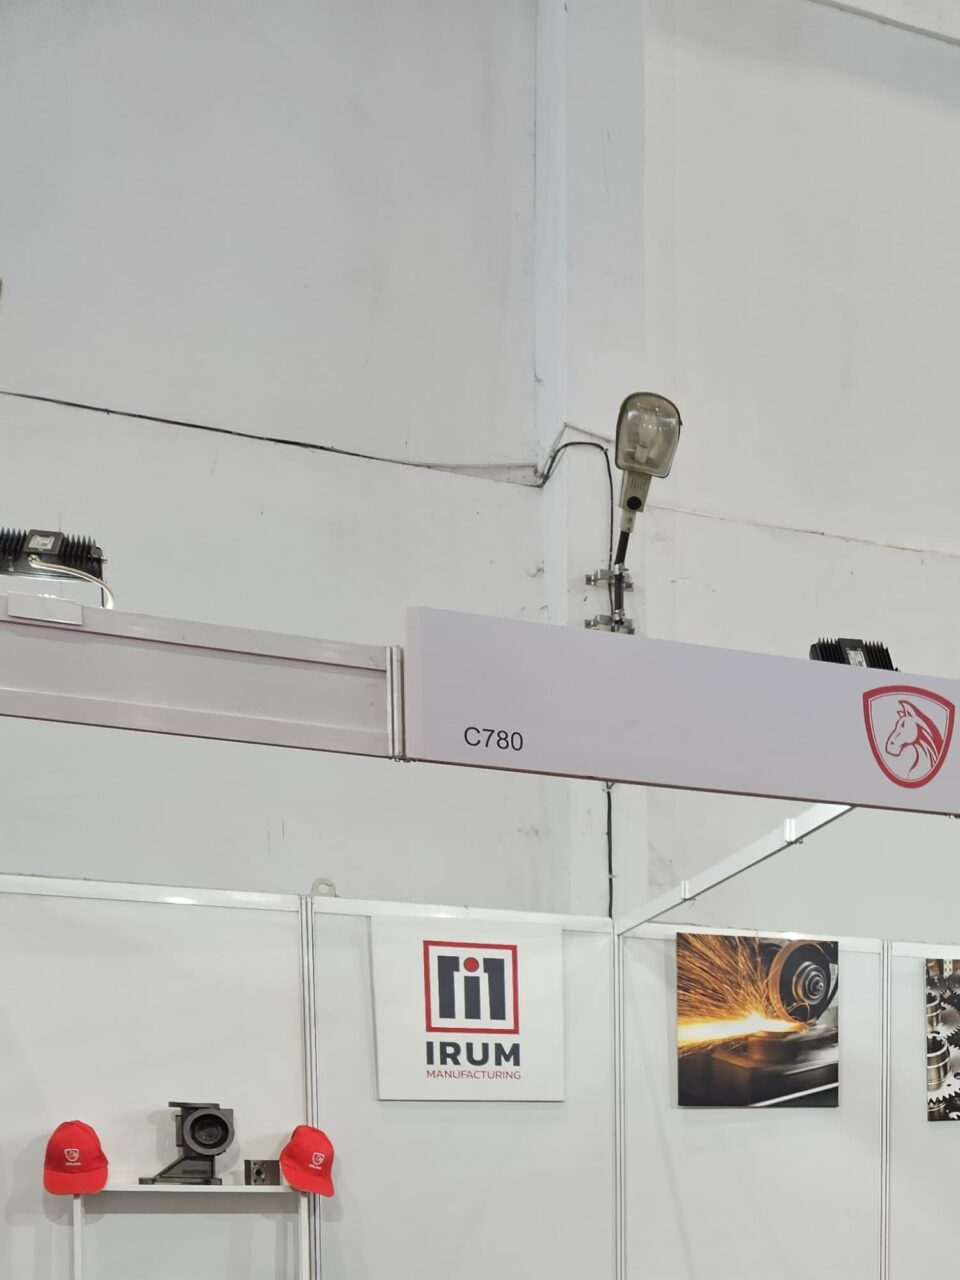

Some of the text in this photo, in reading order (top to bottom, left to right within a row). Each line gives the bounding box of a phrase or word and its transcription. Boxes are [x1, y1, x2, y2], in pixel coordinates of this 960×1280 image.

[464, 726, 523, 751] C780
[426, 1040, 521, 1067] IRUM
[426, 1069, 521, 1080] MANUFACTURING
